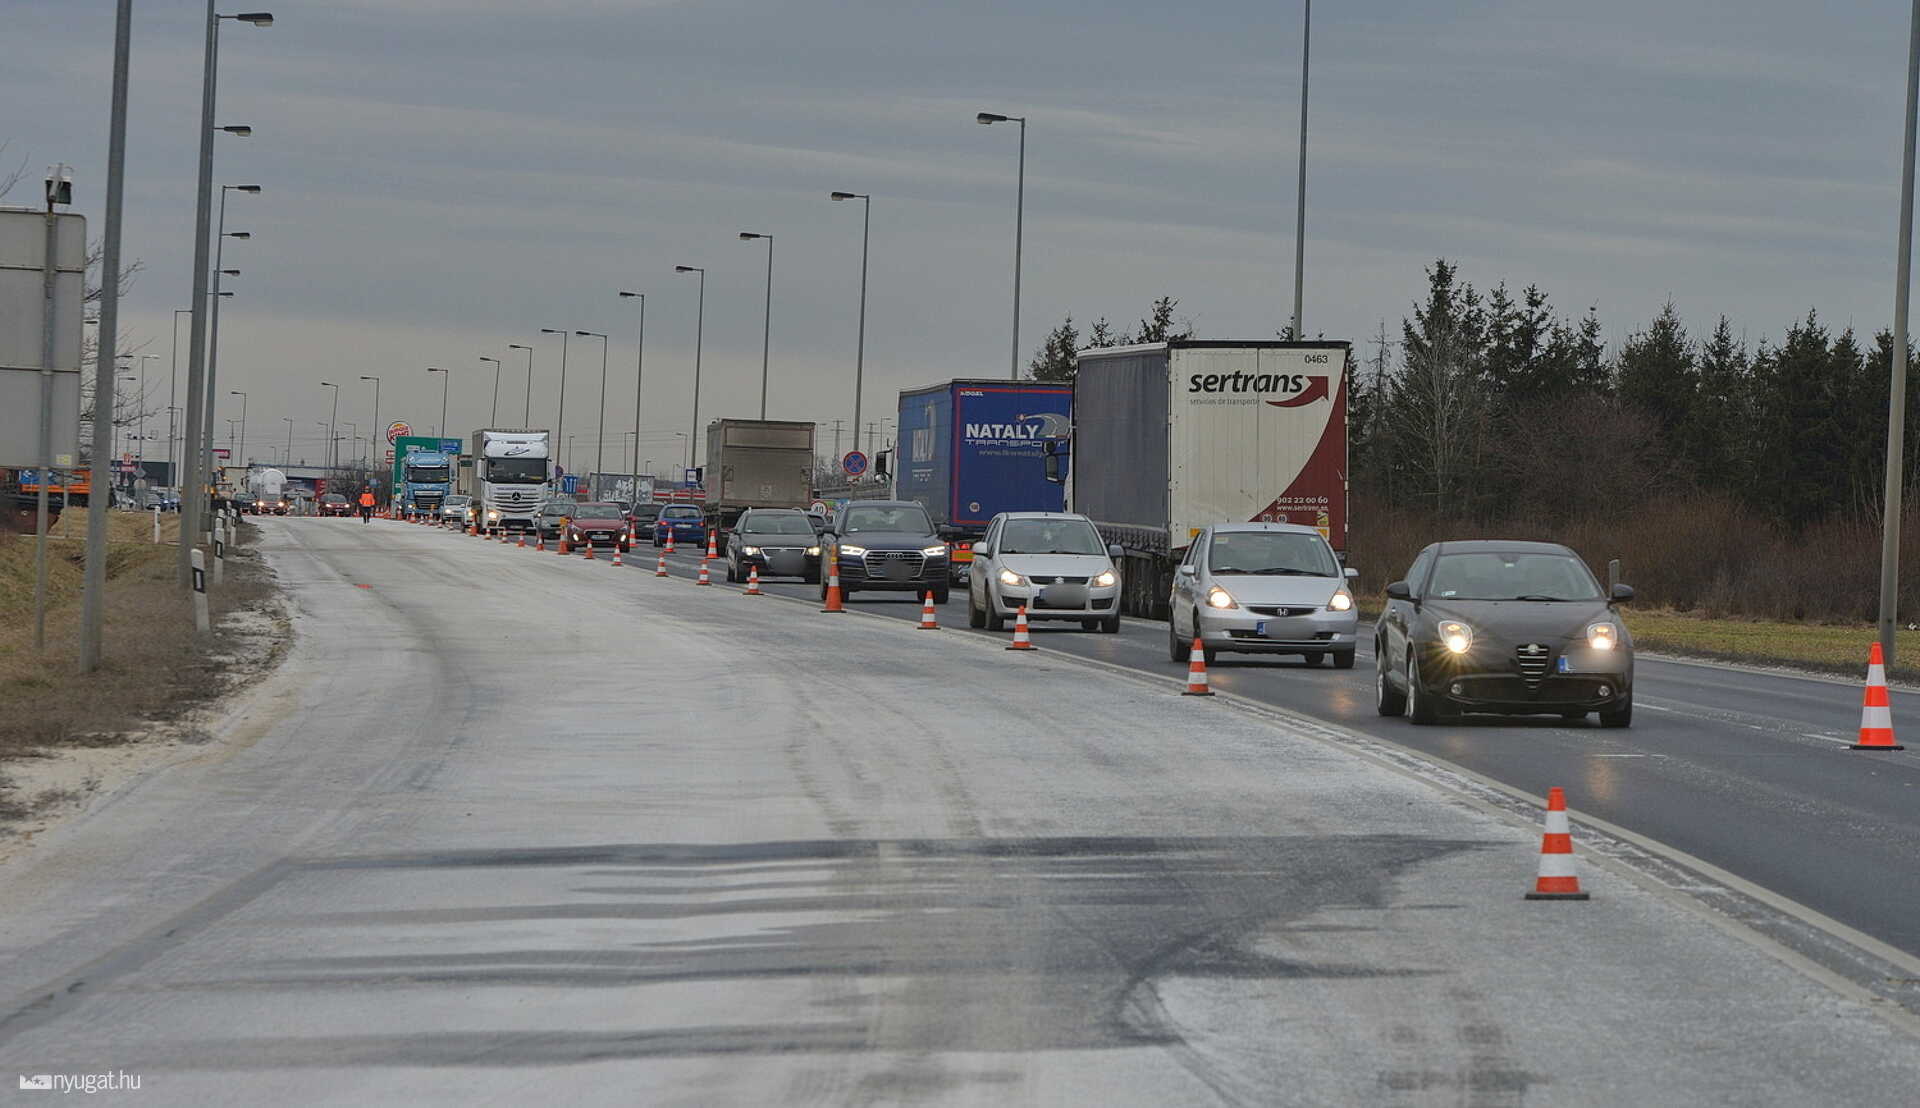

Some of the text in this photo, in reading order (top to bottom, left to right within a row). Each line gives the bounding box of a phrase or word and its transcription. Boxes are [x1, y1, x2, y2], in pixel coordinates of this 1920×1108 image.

[1304, 355, 1328, 364] 0463
[1189, 370, 1303, 393] sertrans
[965, 423, 1039, 439] NATALY
[965, 439, 1065, 447] TRANSPOT
[1277, 497, 1293, 505] 902
[1317, 495, 1328, 504] 60
[815, 505, 824, 513] 40
